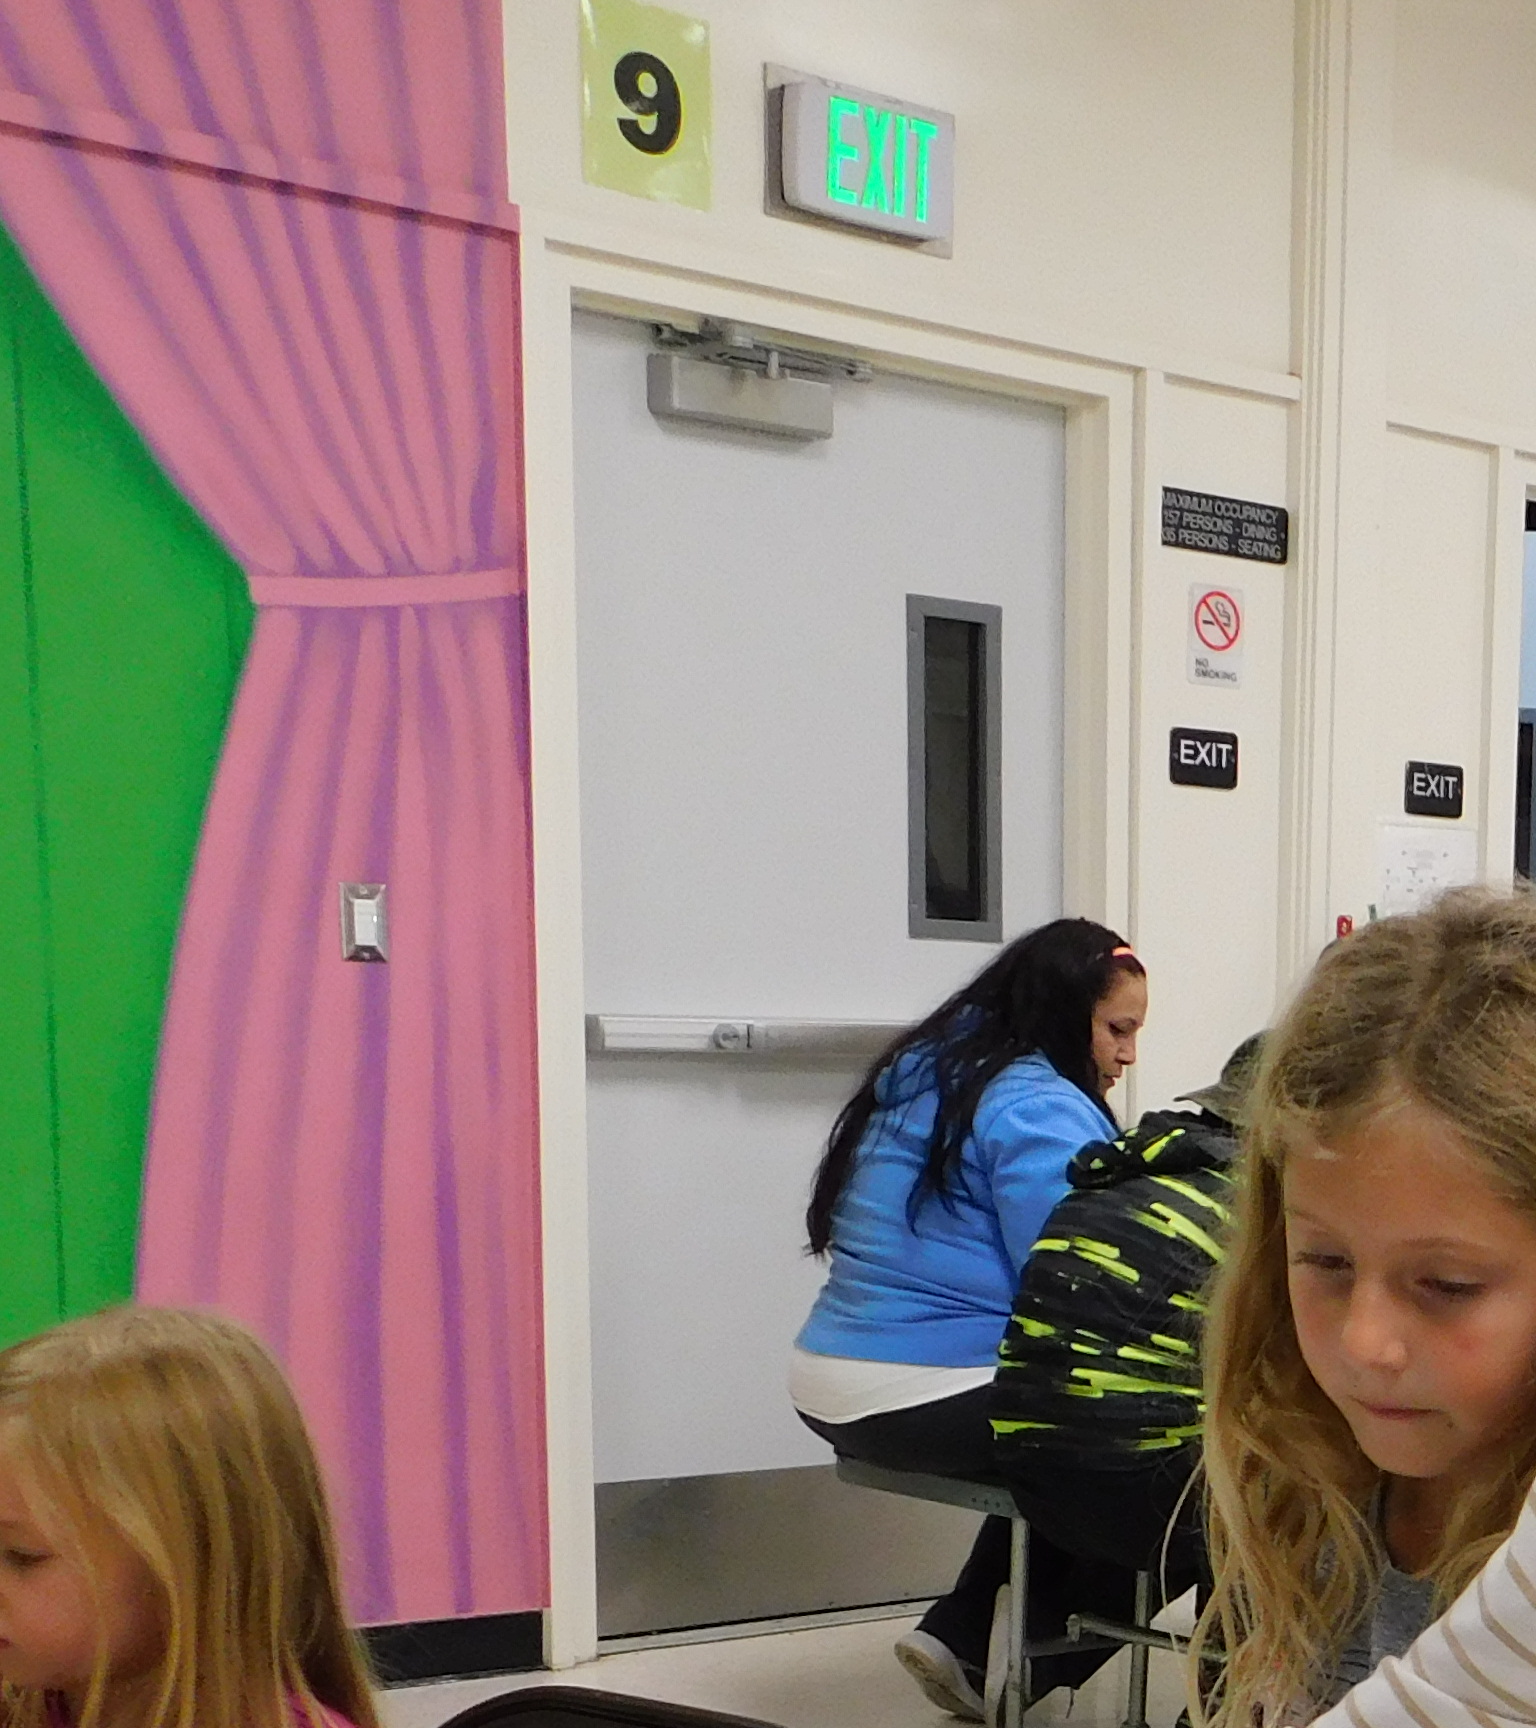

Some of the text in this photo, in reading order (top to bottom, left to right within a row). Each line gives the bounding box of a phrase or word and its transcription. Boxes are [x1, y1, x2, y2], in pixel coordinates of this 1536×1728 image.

[614, 50, 682, 155] 9
[826, 95, 939, 224] EXIT
[1182, 512, 1234, 535] PERSONS
[1242, 522, 1278, 541] DINING
[1214, 500, 1279, 526] OCCUPANCY
[1178, 528, 1230, 552] PERSONS
[1238, 538, 1282, 560] SEATING
[1195, 658, 1209, 671] NO
[1195, 669, 1237, 683] SMOKING
[1179, 738, 1233, 770] EXIT
[1413, 773, 1458, 801] EXIT
